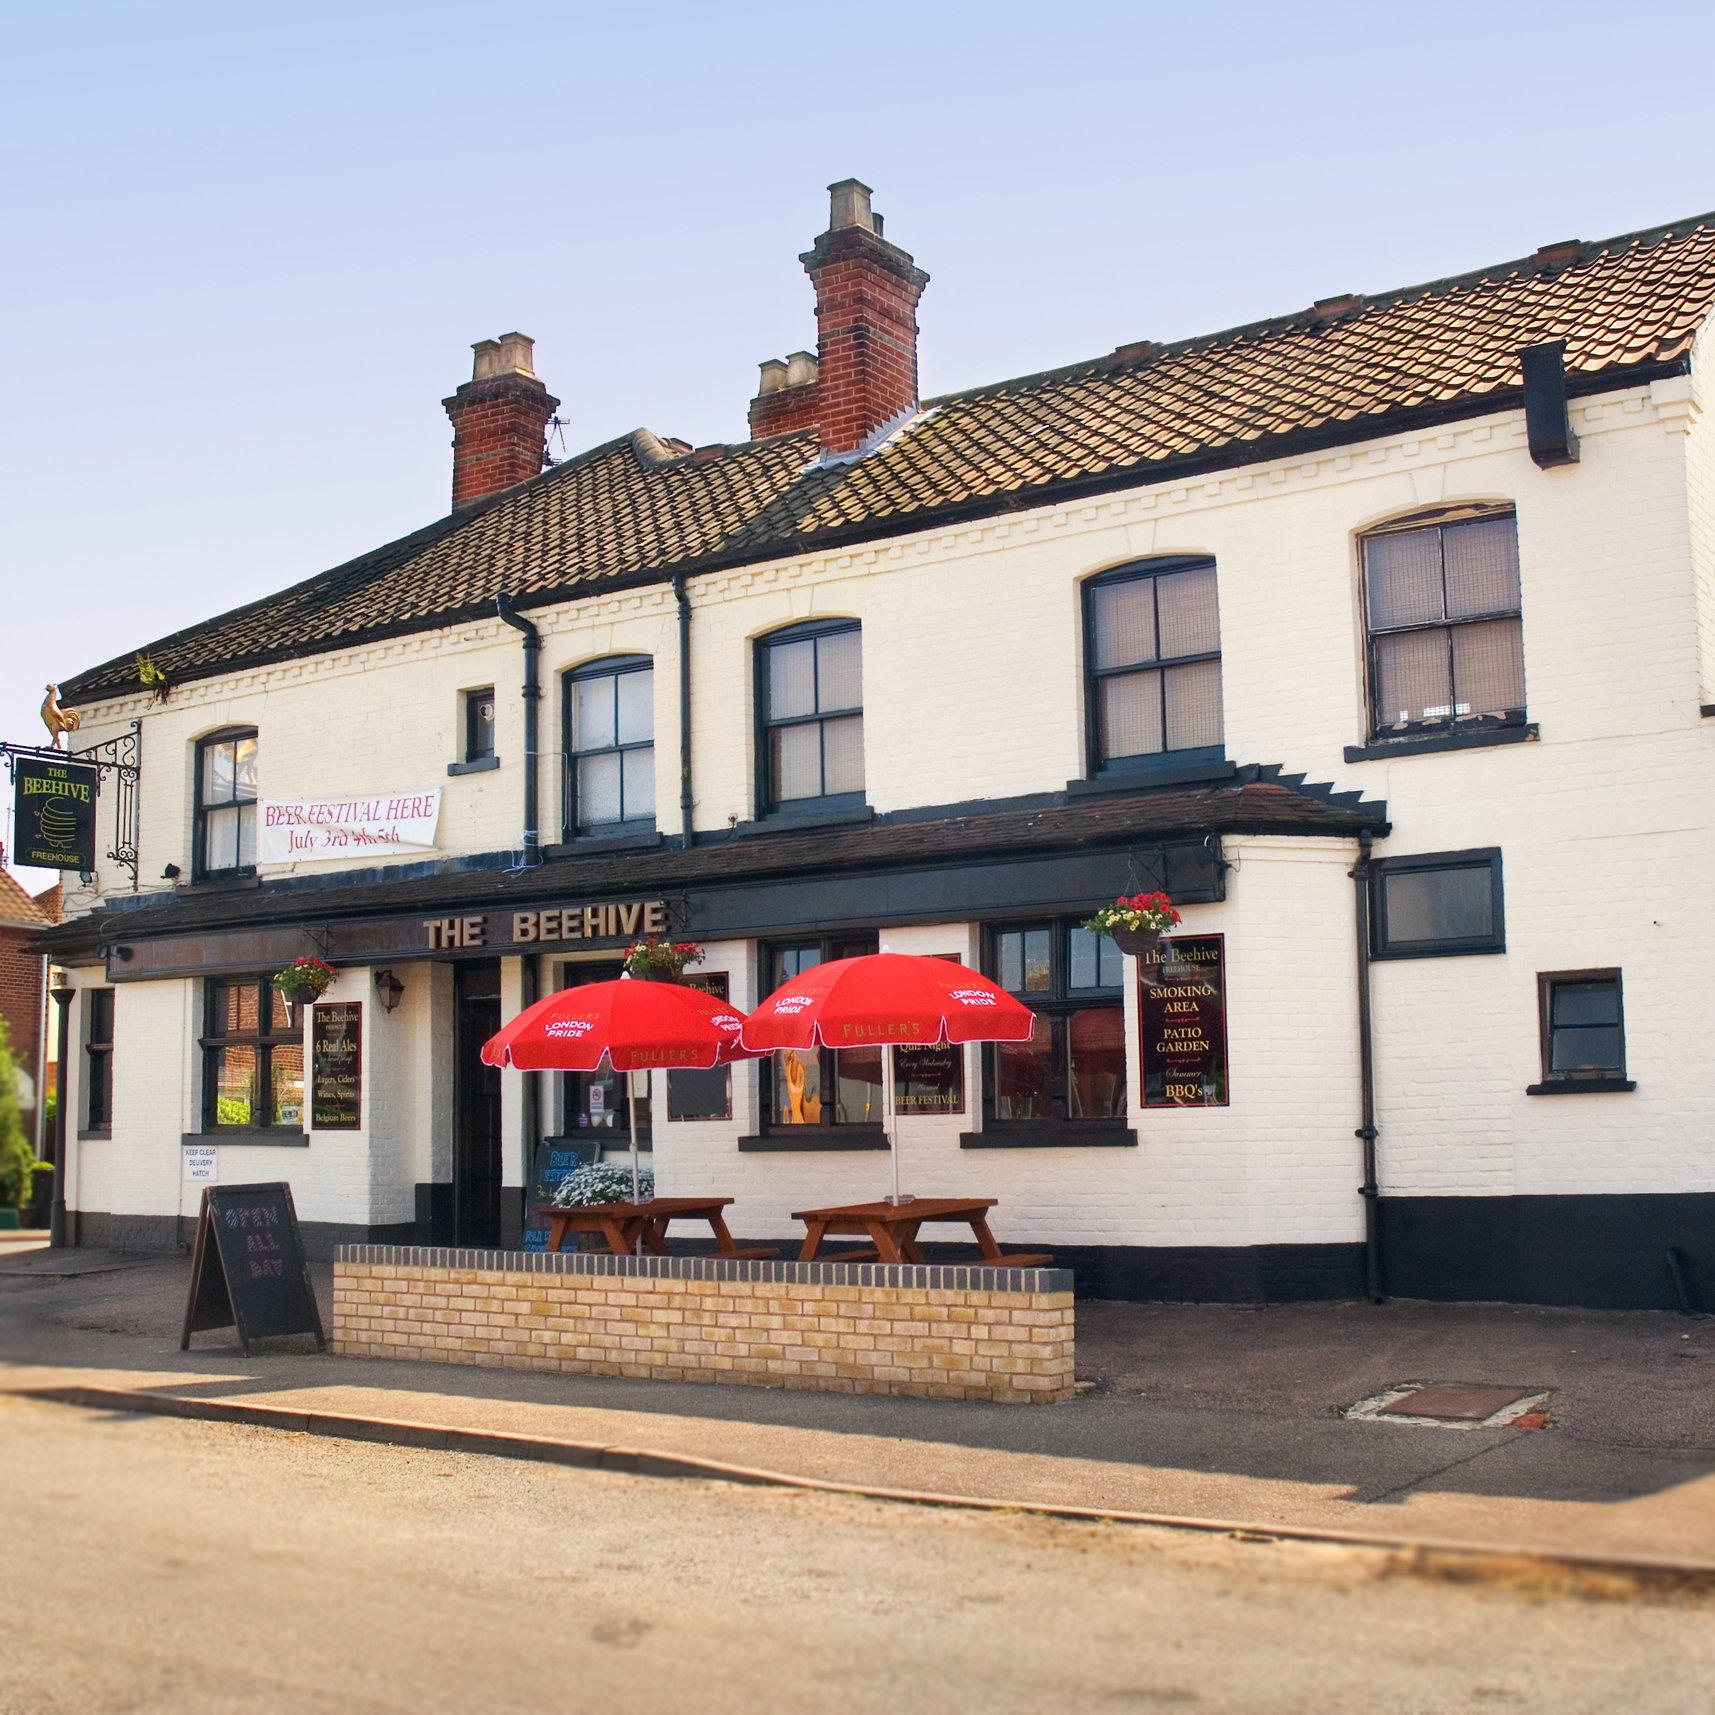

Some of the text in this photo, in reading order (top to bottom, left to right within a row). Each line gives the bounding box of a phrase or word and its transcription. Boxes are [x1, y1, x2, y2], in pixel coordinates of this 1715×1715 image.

[47, 768, 68, 778] THE
[23, 776, 90, 803] BEEHIVE
[266, 796, 434, 826] BEER FESTIVAL HERE
[288, 830, 318, 853] July
[321, 830, 348, 848] 3rd
[378, 826, 400, 844] 5th
[31, 850, 80, 864] FREEHOUSE
[422, 901, 667, 950] THE BEEHIVE
[1145, 946, 1218, 964] The Beehive
[1162, 964, 1200, 974] FREEHOUSE
[948, 990, 996, 1000] LONDON
[1150, 985, 1211, 999] SMOKING
[776, 996, 814, 1006] LONDON
[960, 998, 996, 1006] PRIDE
[773, 1006, 804, 1014] PRIDE
[1164, 1002, 1199, 1014] AREA
[316, 1010, 358, 1022] The Beehive
[710, 1015, 740, 1026] LONDON
[545, 1020, 594, 1030] LONDON
[844, 1020, 920, 1038] FULLER'S
[1164, 1027, 1202, 1039] PATIO
[316, 1038, 358, 1052] 6 Real Ales
[1156, 1040, 1210, 1053] GARDEN
[1165, 1066, 1202, 1078] Summer
[1165, 1084, 1202, 1098] BBQ's
[896, 1094, 958, 1105] BEER FESTIVAL
[200, 1148, 216, 1156] CLEAR
[550, 1151, 578, 1166] BEER
[226, 1206, 279, 1228] OPEN
[246, 1233, 280, 1252] ALL
[250, 1259, 282, 1278] DAY
